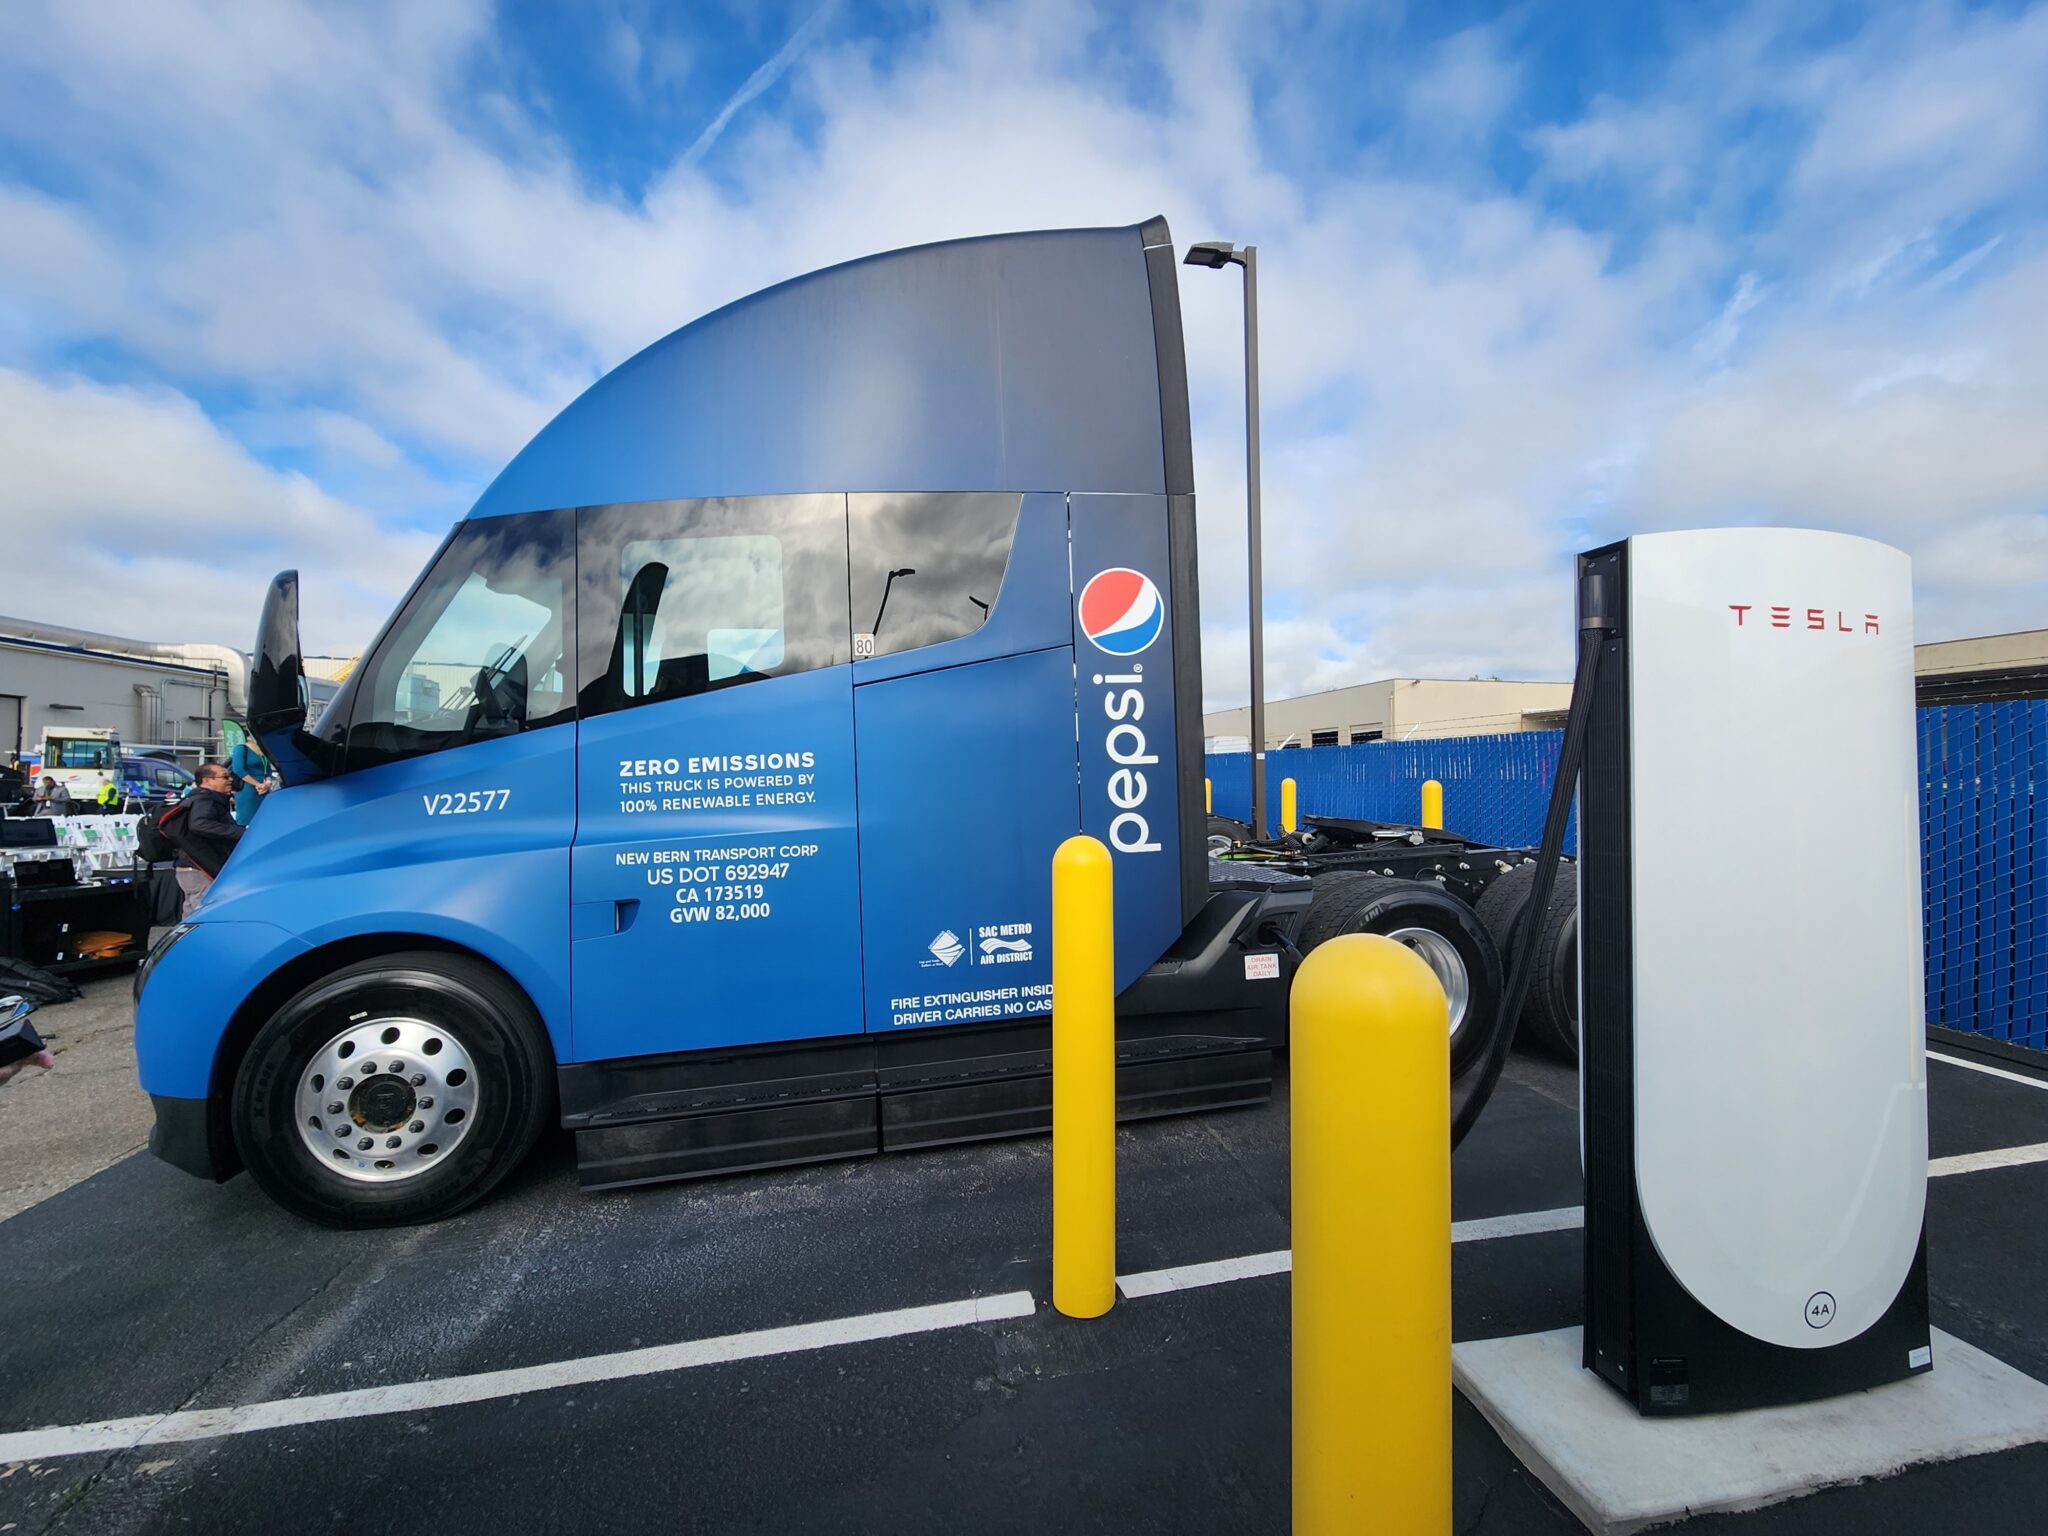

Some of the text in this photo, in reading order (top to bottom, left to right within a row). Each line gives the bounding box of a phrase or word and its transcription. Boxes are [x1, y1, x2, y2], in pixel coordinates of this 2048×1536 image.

[1728, 605, 1879, 635] TESLA
[856, 639, 873, 654] 80
[620, 752, 815, 776] ZERO EMISSIONS
[620, 774, 814, 793] THIS TRUCK IS POWERED BY
[424, 789, 510, 815] V22577
[620, 791, 816, 812] 100% RENEWABLE ENERGY.
[616, 845, 818, 865] NEW BERN TRANSPORT CORP
[648, 863, 790, 885] US DOT 692947
[676, 884, 763, 903] CA 173519
[670, 903, 770, 923] GVW 82,000
[979, 923, 1032, 938] SAC METRO
[980, 951, 1033, 965] AIR DISTRICT
[891, 984, 1053, 1010] FIRE EXTINGUISHER INSID
[894, 999, 1053, 1025] DRIVER CARRIES NO CAS
[1811, 1303, 1830, 1317] 4A
